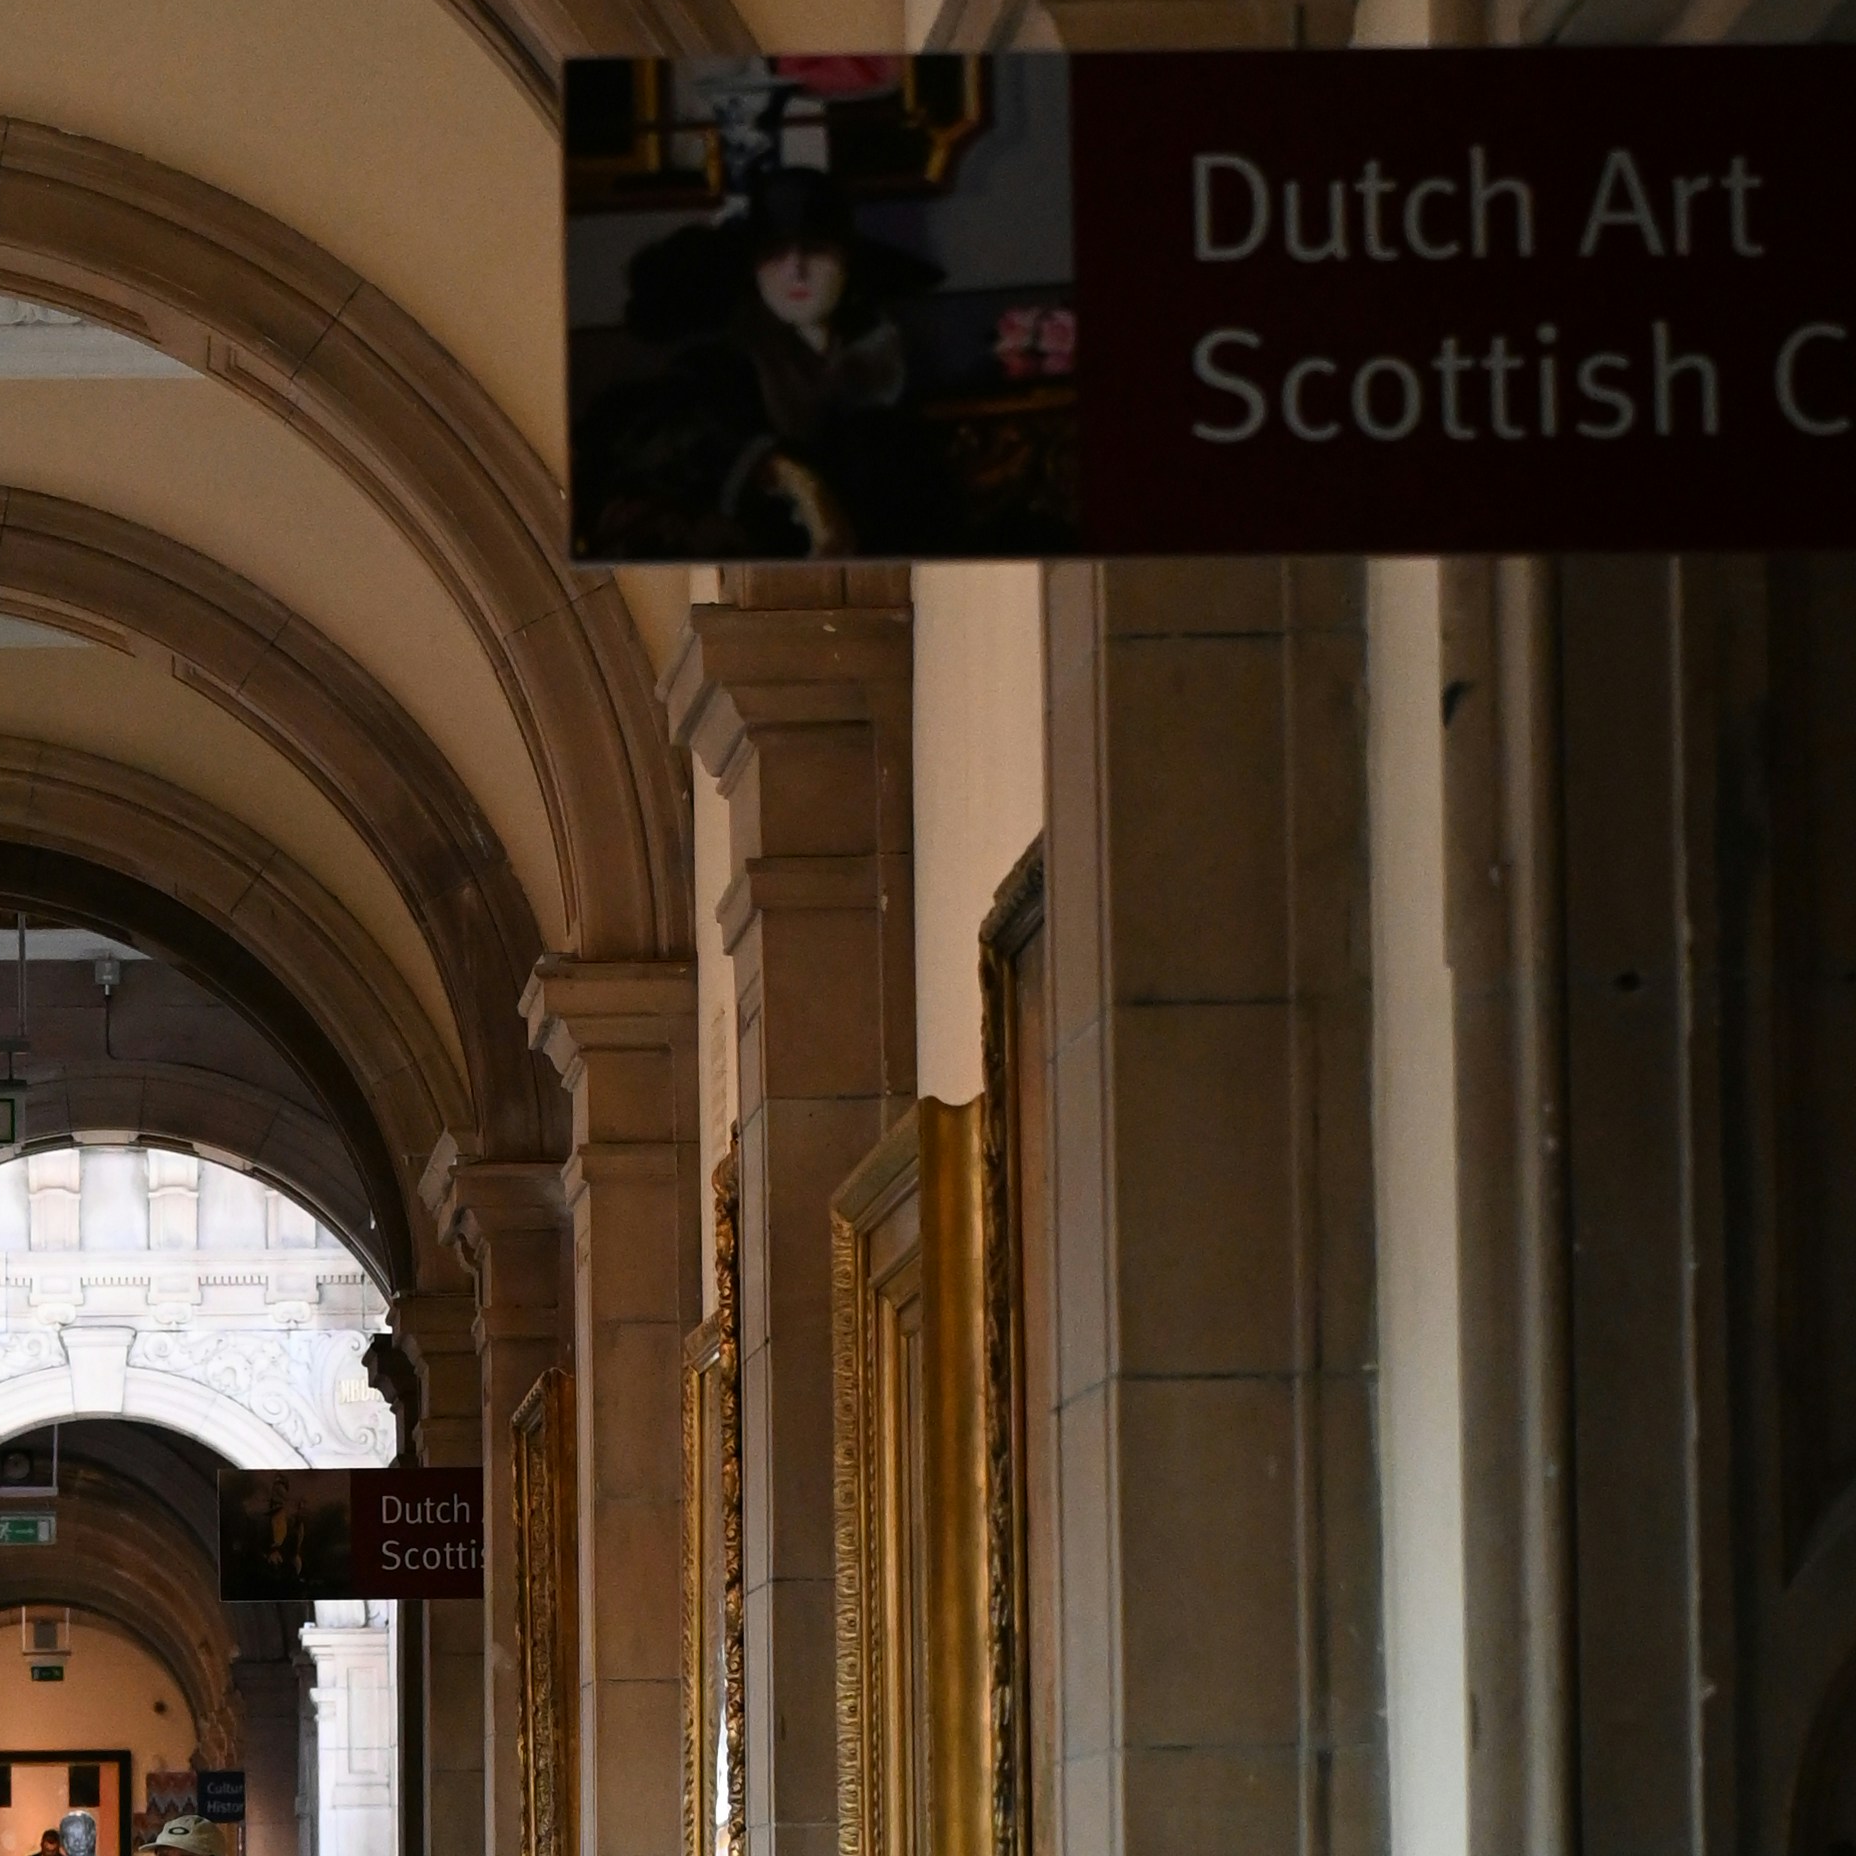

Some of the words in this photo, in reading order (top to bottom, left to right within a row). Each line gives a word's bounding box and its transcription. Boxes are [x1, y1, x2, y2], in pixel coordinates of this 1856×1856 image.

[1192, 144, 1535, 262] Dutch
[1577, 149, 1766, 257] Art
[1191, 319, 1721, 441] Scottish
[381, 1493, 471, 1524] Dutch
[381, 1539, 484, 1571] Scotti
